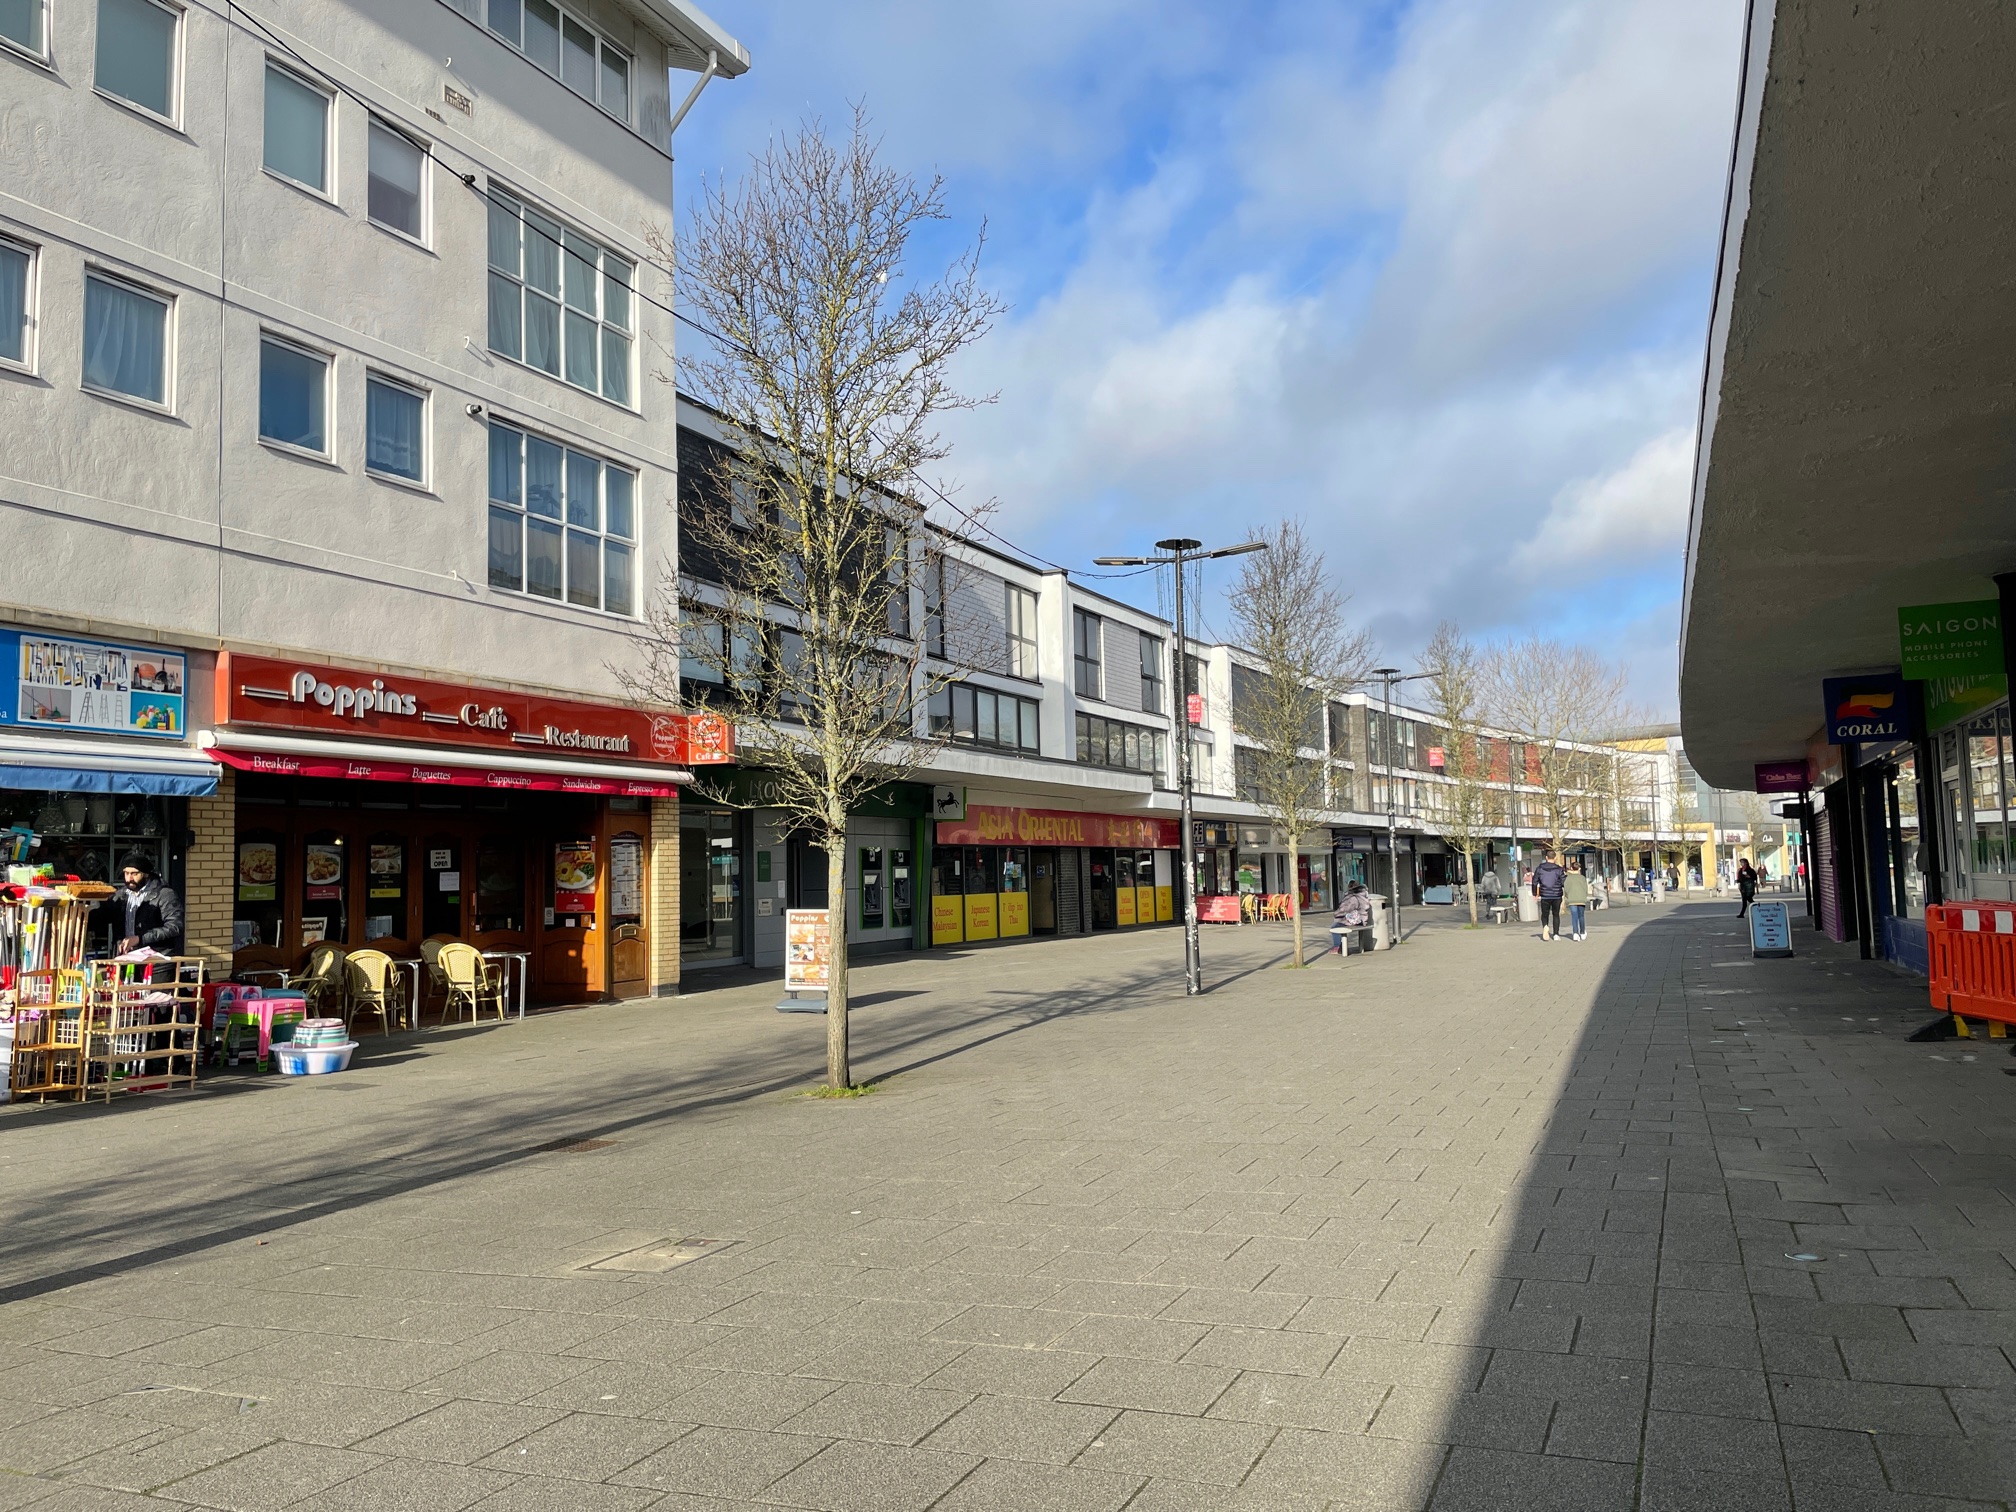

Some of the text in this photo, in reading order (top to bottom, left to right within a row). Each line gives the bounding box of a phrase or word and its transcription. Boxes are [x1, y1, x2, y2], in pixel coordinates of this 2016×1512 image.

[1903, 616, 1997, 637] SAIGON
[1904, 640, 1989, 653] MOBILE PHONE
[1906, 651, 1979, 662] ACCESSORIES
[291, 671, 630, 753] Poppins Café Restaurant
[1836, 722, 1898, 737] CORAL
[253, 756, 654, 794] Breakfast Latte Baguettes Cappuccino Sandwiches Espresso
[978, 811, 1013, 841] ASIA
[1018, 811, 1085, 842] ORIENTAL
[934, 907, 954, 917] Chinese
[971, 905, 990, 916] Japanese
[790, 914, 819, 923] Poppins
[972, 918, 989, 928] Korean
[932, 920, 957, 932] Malaysian
